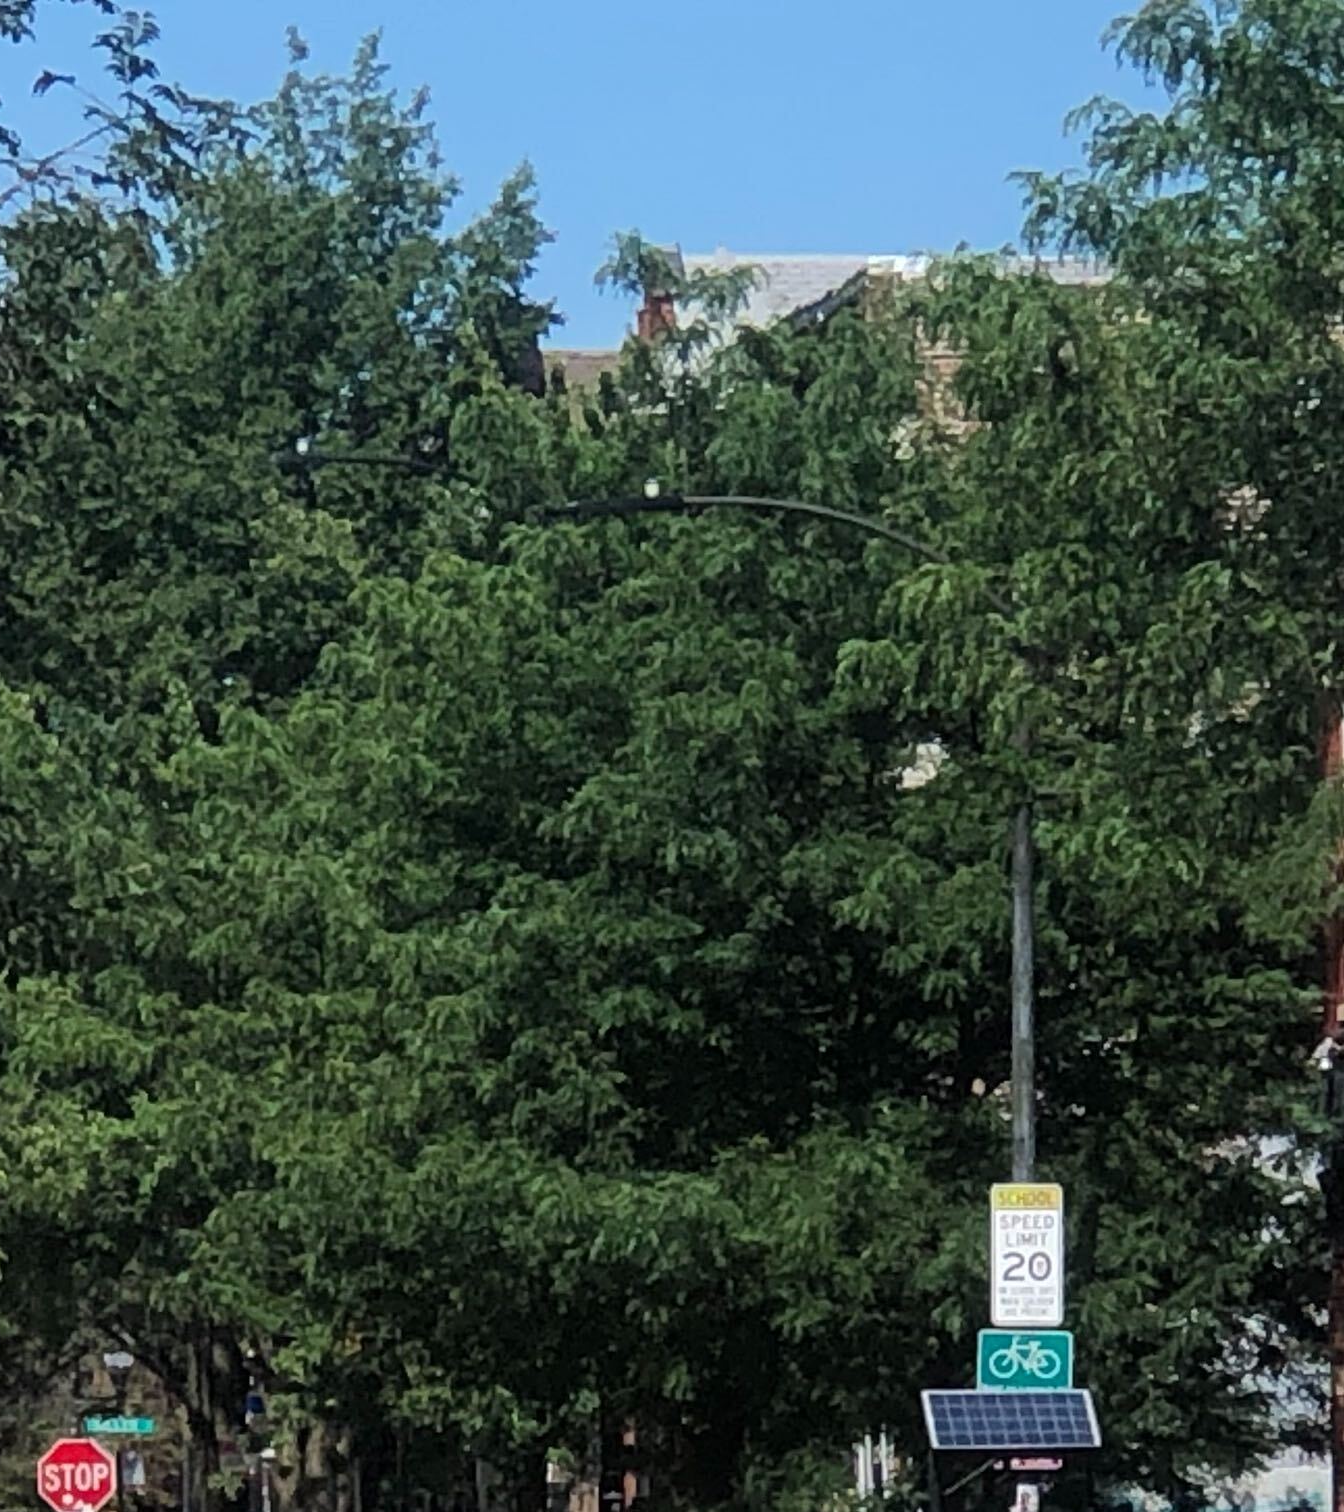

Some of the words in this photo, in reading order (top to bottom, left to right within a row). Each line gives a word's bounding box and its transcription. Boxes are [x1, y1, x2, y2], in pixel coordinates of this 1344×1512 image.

[999, 1191, 1052, 1207] SCHOOL
[999, 1214, 1054, 1230] SPEED
[1005, 1232, 1048, 1248] LIMIT
[1002, 1251, 1052, 1281] 20
[44, 1463, 109, 1492] STOP
